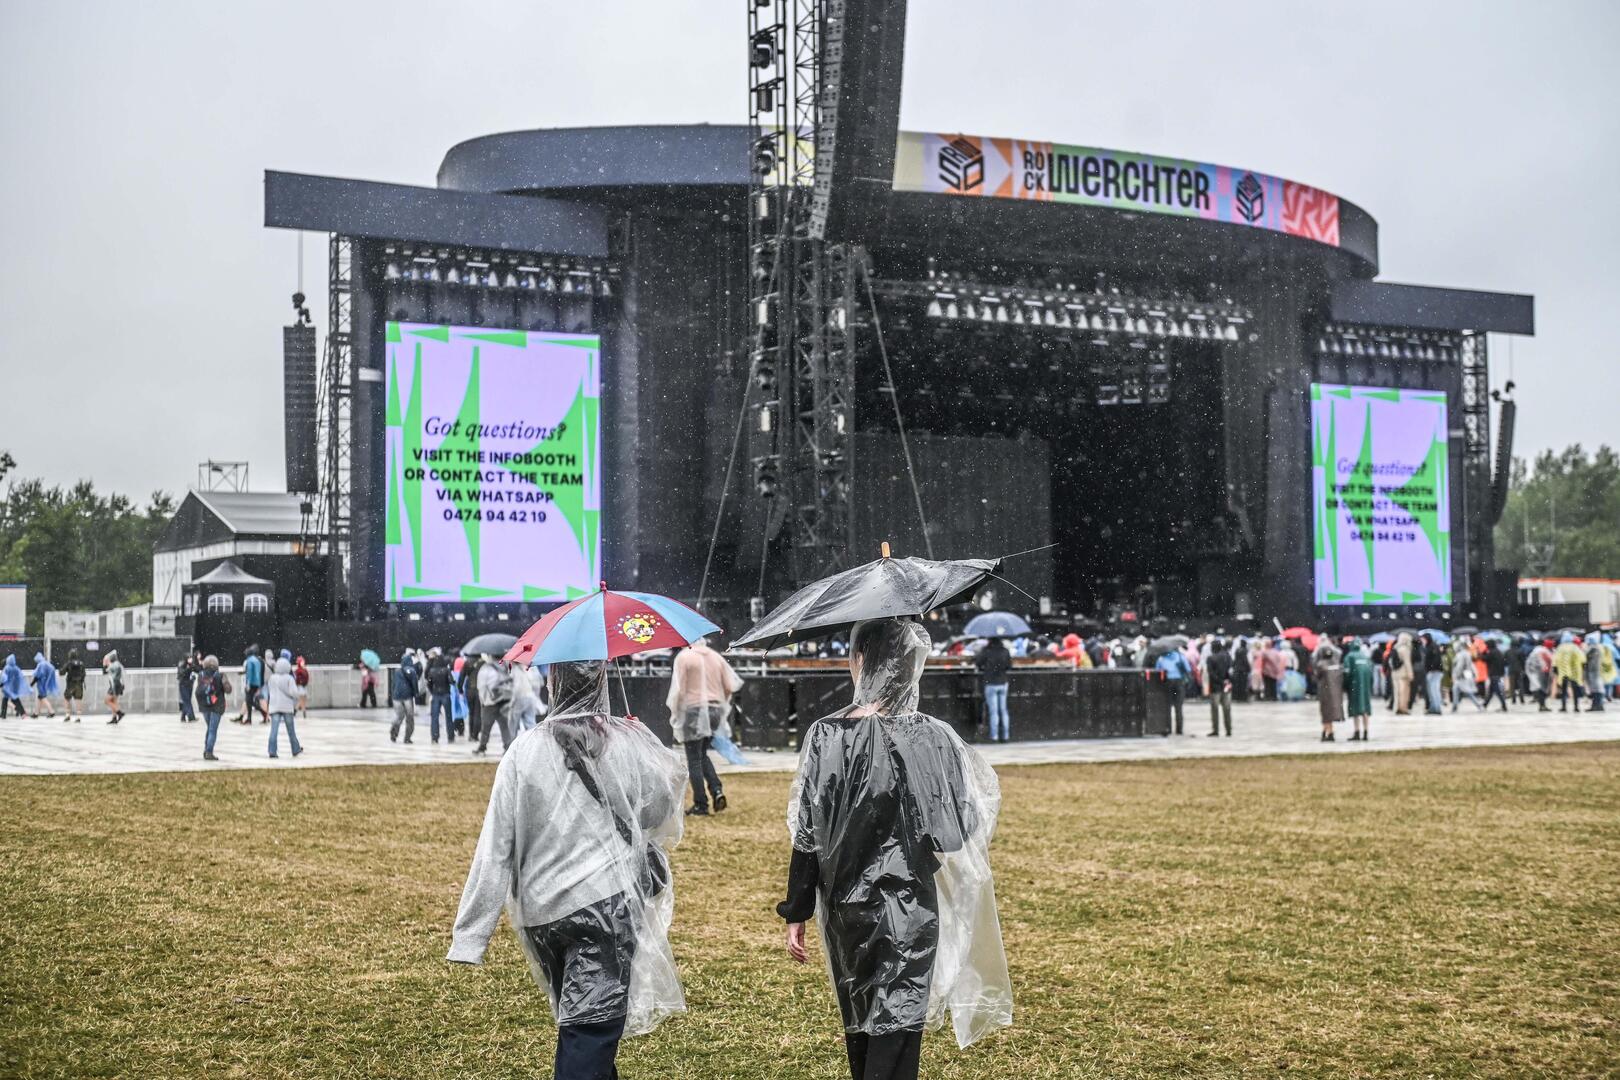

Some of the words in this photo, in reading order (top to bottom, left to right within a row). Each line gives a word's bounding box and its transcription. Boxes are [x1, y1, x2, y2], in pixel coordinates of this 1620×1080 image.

[425, 416, 461, 437] Got
[465, 420, 567, 442] questions?
[413, 448, 452, 462] VISIT
[456, 449, 485, 463] THE
[489, 451, 576, 467] INFOBOOTH
[404, 467, 425, 481] OR
[430, 468, 505, 483] CONTACT
[509, 471, 537, 484] THE
[541, 472, 583, 486] TEAM
[436, 489, 462, 501] VIA
[467, 489, 554, 503] WHATSAPP
[443, 508, 482, 522] 0474
[486, 510, 505, 522] 94
[509, 510, 527, 522] 42
[531, 510, 547, 523] 19
